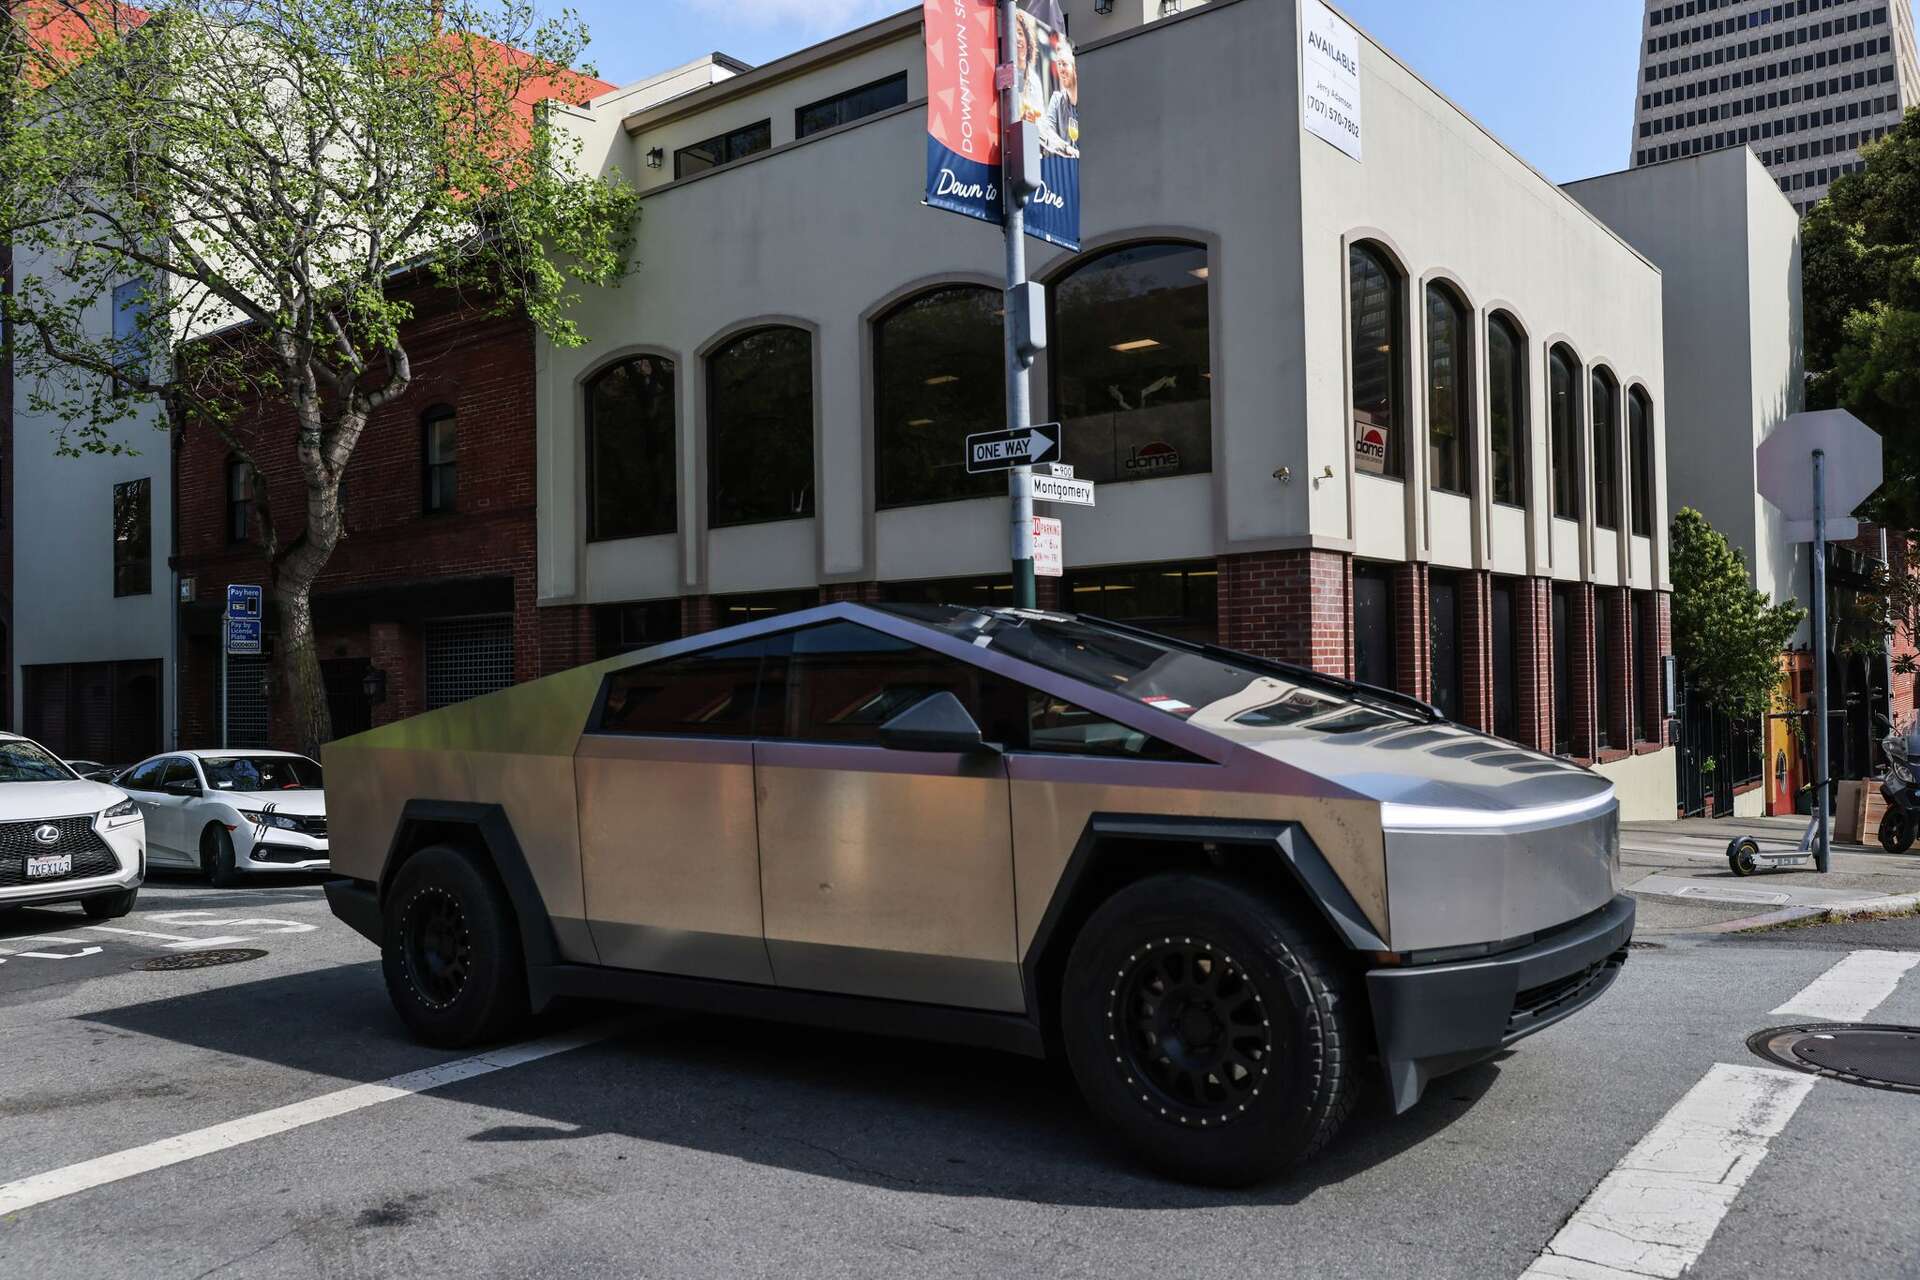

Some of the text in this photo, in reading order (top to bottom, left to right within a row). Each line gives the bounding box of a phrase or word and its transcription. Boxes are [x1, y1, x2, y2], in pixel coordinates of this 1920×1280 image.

[1308, 30, 1357, 77] AVAILABLE
[956, 24, 973, 153] DOWNTOWN
[1306, 95, 1359, 138] (707) 570-7802
[937, 168, 998, 201] Down to
[1034, 180, 1064, 209] Dine
[977, 439, 1031, 459] ONE WAY
[1355, 426, 1384, 458] dome
[1126, 446, 1178, 469] dome
[1060, 466, 1072, 478] 900
[1034, 480, 1090, 502] Montgomery
[1041, 523, 1060, 536] PARKING
[231, 588, 259, 597] Pay here
[29, 861, 70, 876] 7KEX143
